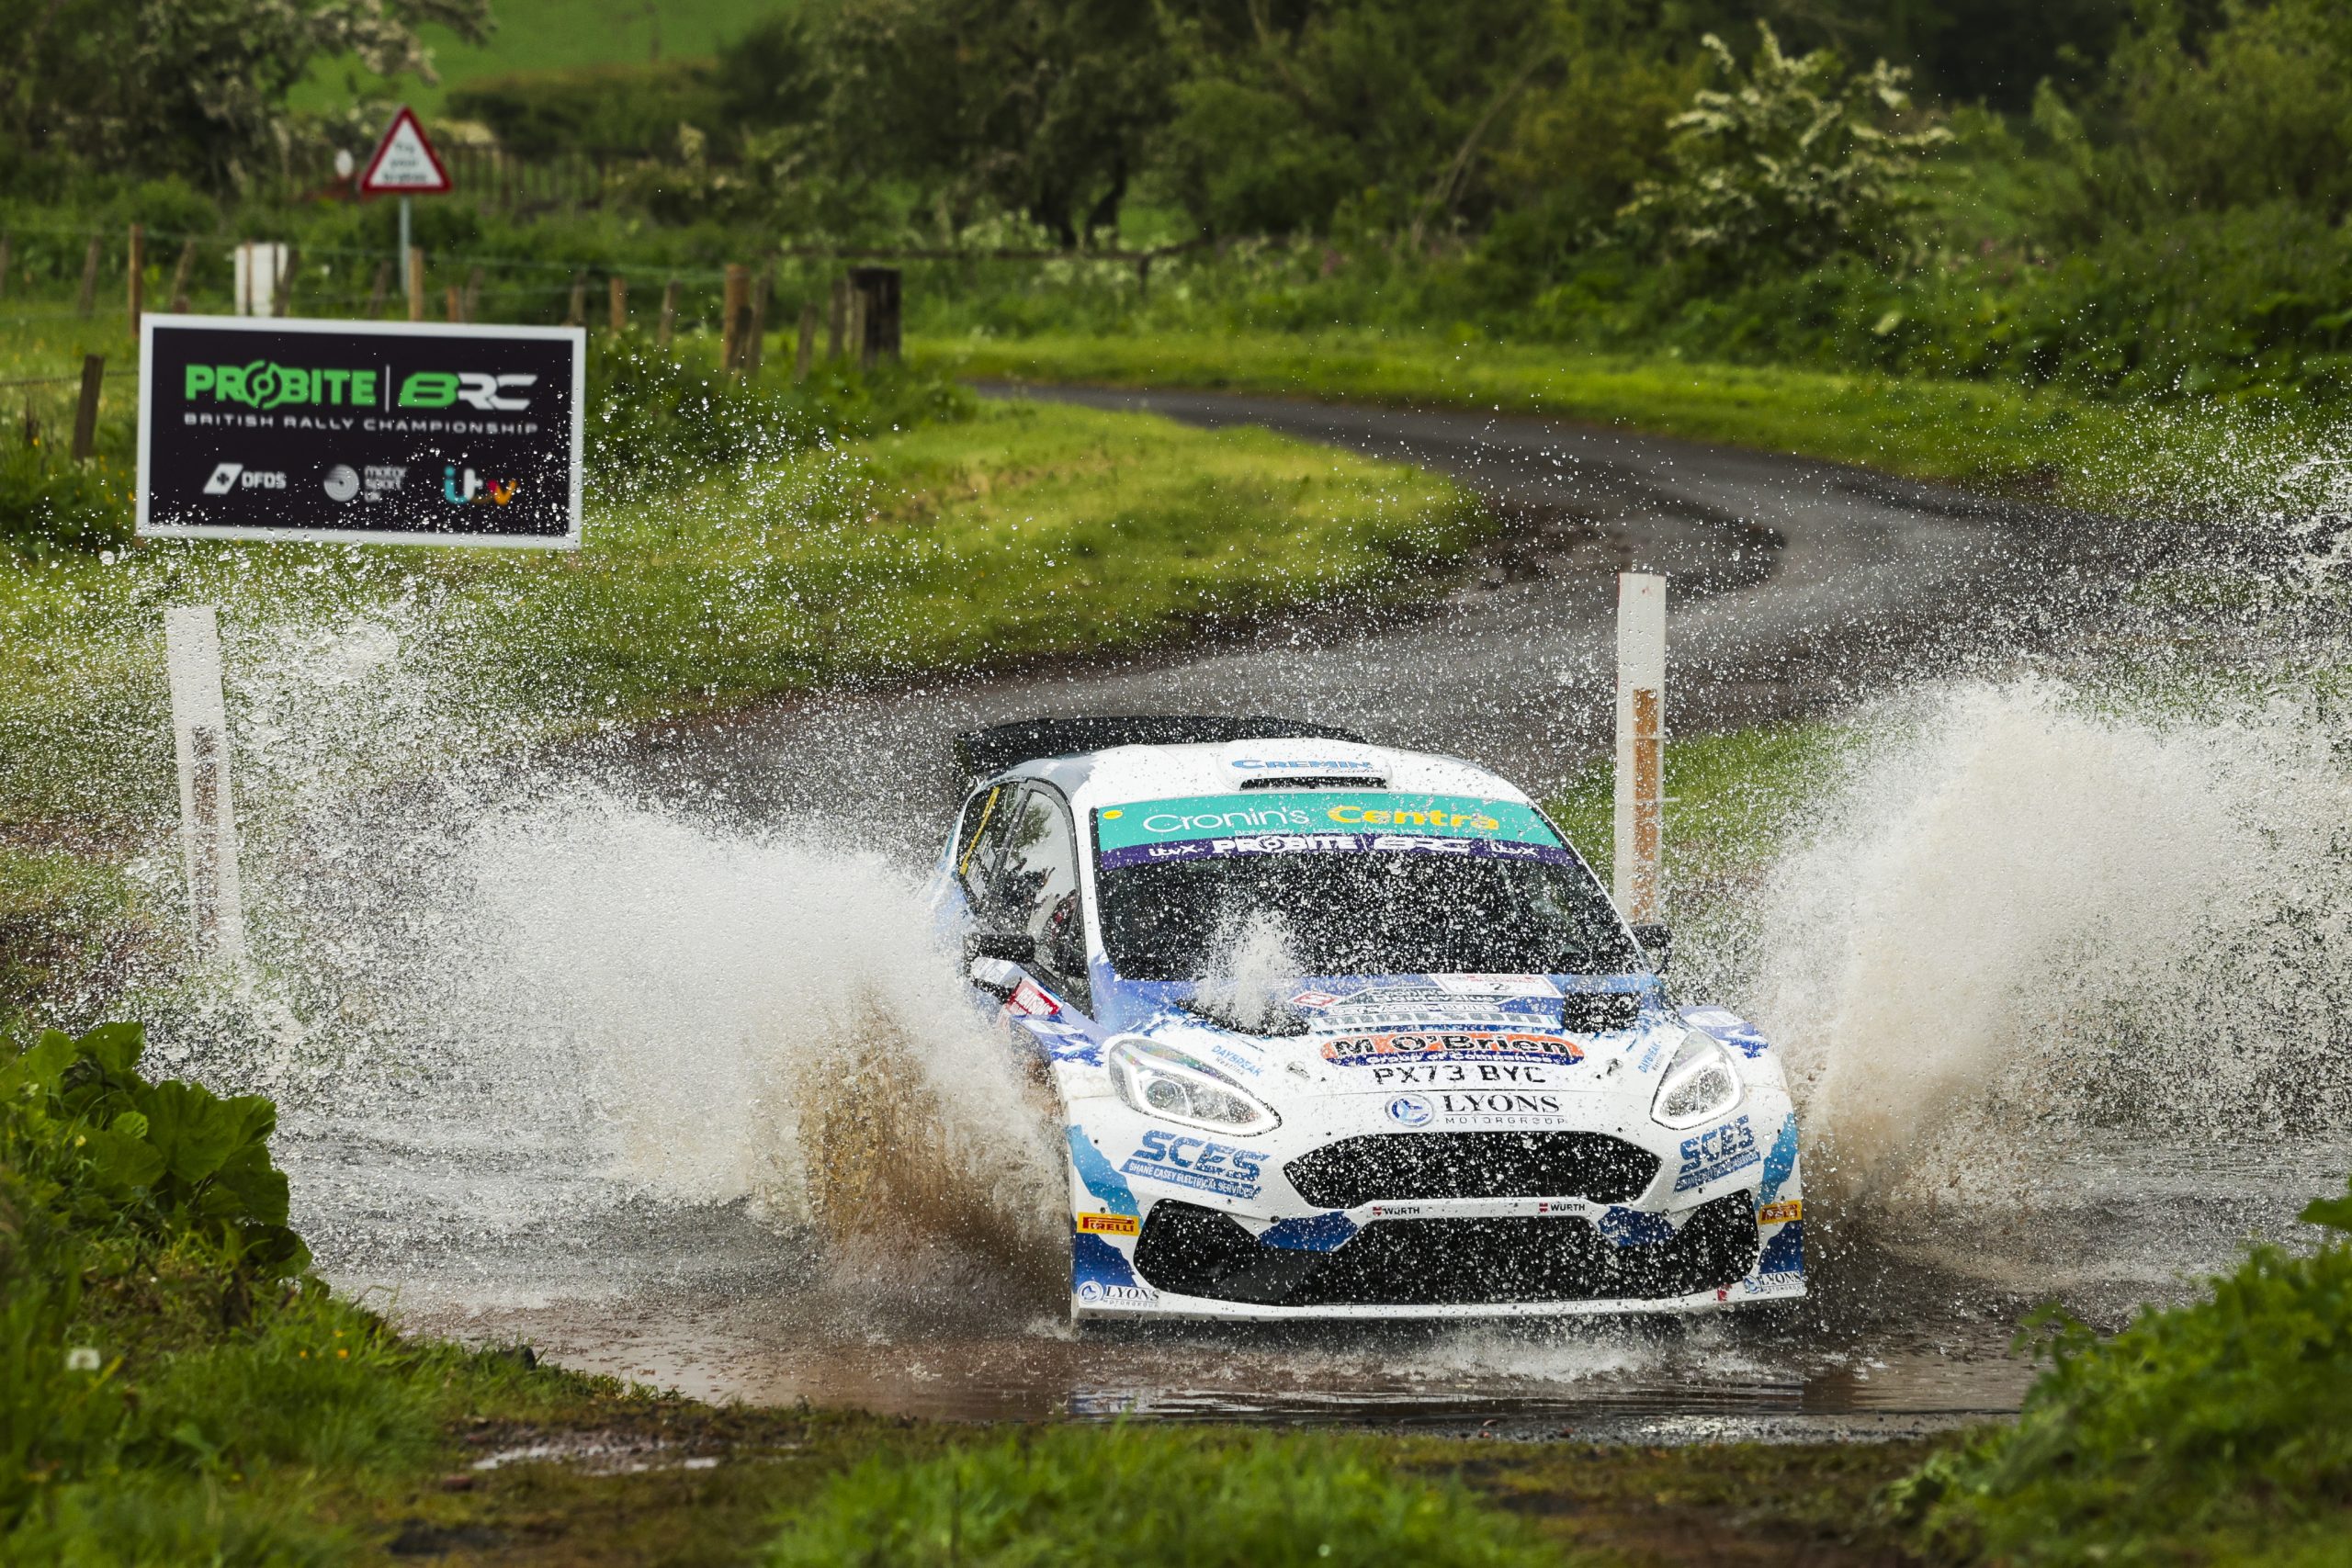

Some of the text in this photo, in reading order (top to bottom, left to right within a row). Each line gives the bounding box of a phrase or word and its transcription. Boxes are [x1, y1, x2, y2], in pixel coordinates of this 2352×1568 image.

[185, 359, 538, 411] PROBITE BRC
[184, 412, 538, 434] BRITISH RALLY CHAMPIONSHIP
[242, 471, 287, 489] DFDS
[444, 465, 517, 506] itv
[1143, 806, 1499, 833] Cronin's Centra
[1212, 835, 1358, 854] PROBITE
[1391, 1034, 1571, 1057] O'Brien
[1366, 1055, 1421, 1065] Group
[1452, 1053, 1553, 1063] Companies
[1374, 1065, 1546, 1085] PX73 BYC
[1442, 1094, 1560, 1113] LYONS
[1445, 1116, 1566, 1124] MOTORGROUP
[1132, 1129, 1272, 1182] SCES
[1128, 1162, 1154, 1175] SHANE
[1154, 1168, 1177, 1181] CASEY
[1177, 1172, 1217, 1190] ELECTRICAL
[1082, 1216, 1135, 1232] PIRELLI
[1760, 1271, 1802, 1286] LYONS
[1106, 1286, 1159, 1302] LYONS
